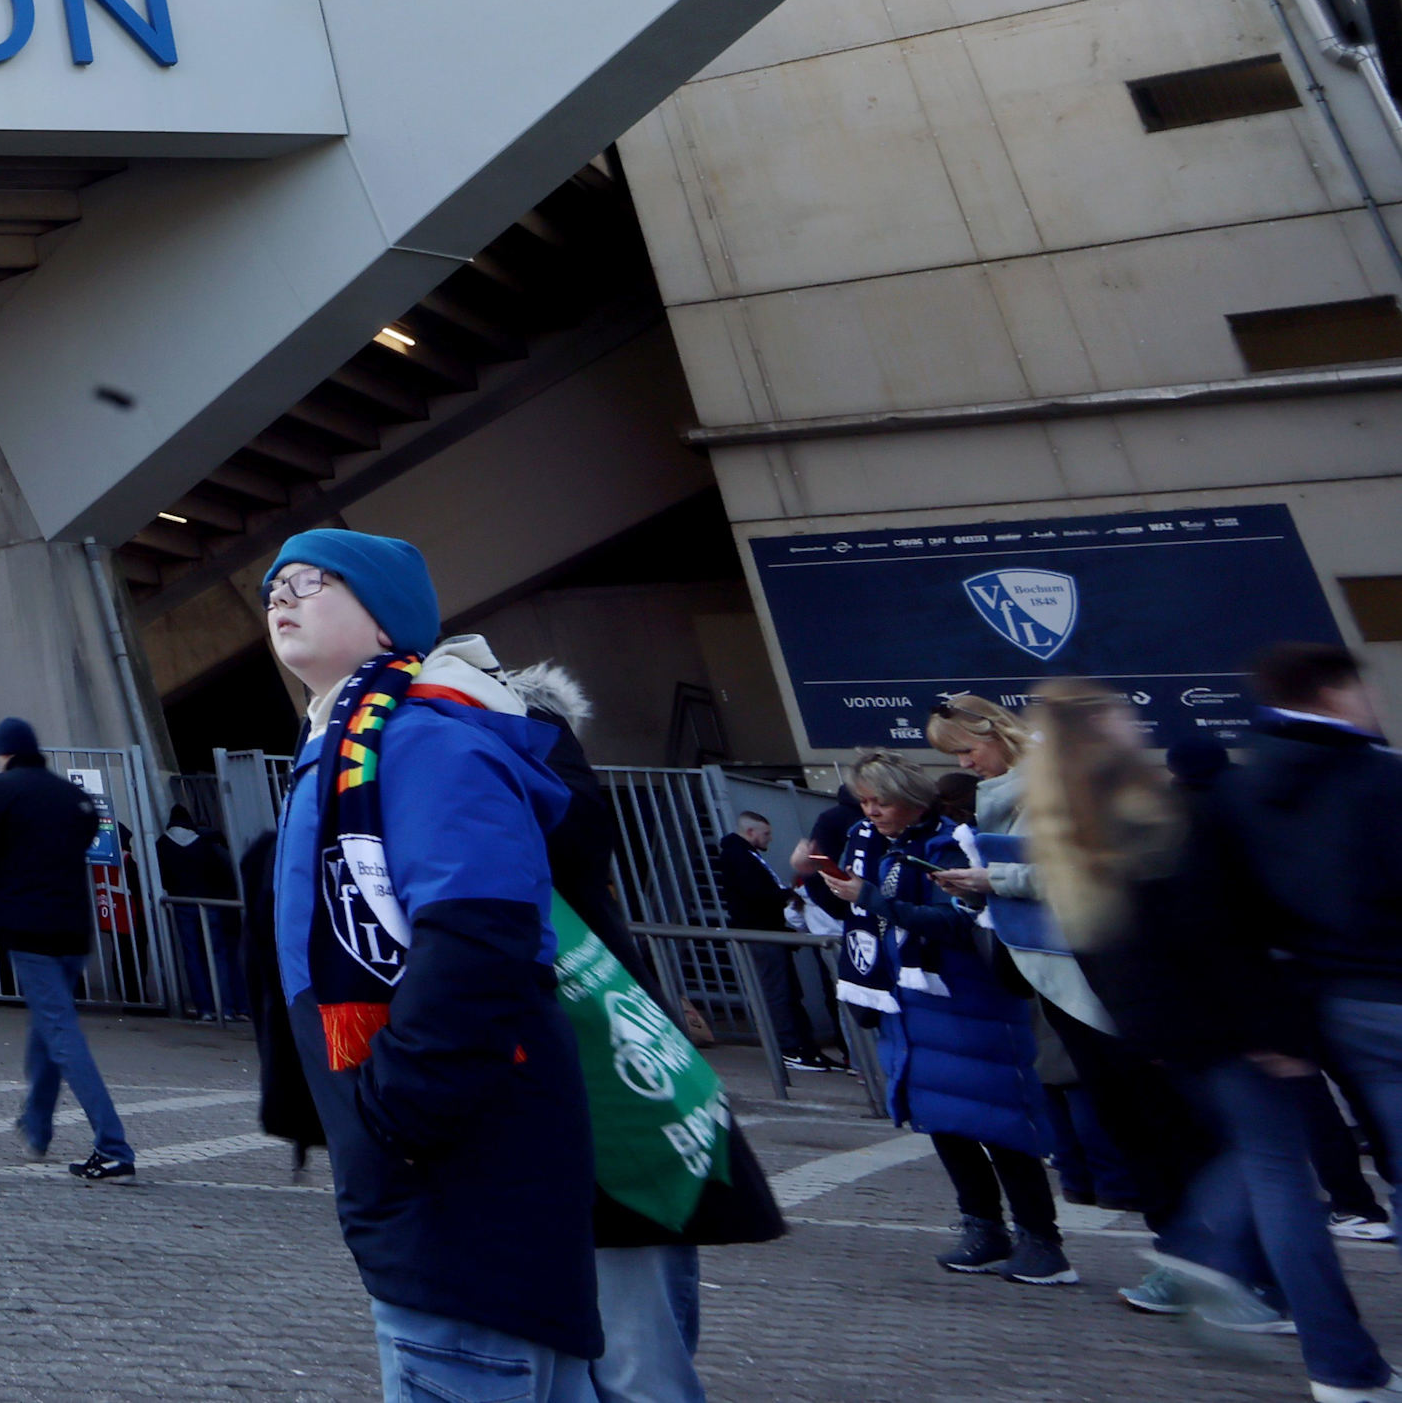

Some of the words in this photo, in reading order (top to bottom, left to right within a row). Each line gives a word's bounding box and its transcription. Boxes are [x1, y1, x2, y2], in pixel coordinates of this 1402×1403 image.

[1148, 522, 1175, 531] WAZ
[1014, 584, 1064, 594] Bochum
[1030, 597, 1058, 606] 1848
[843, 696, 913, 708] VONOVIA
[889, 727, 924, 739] FIEGE
